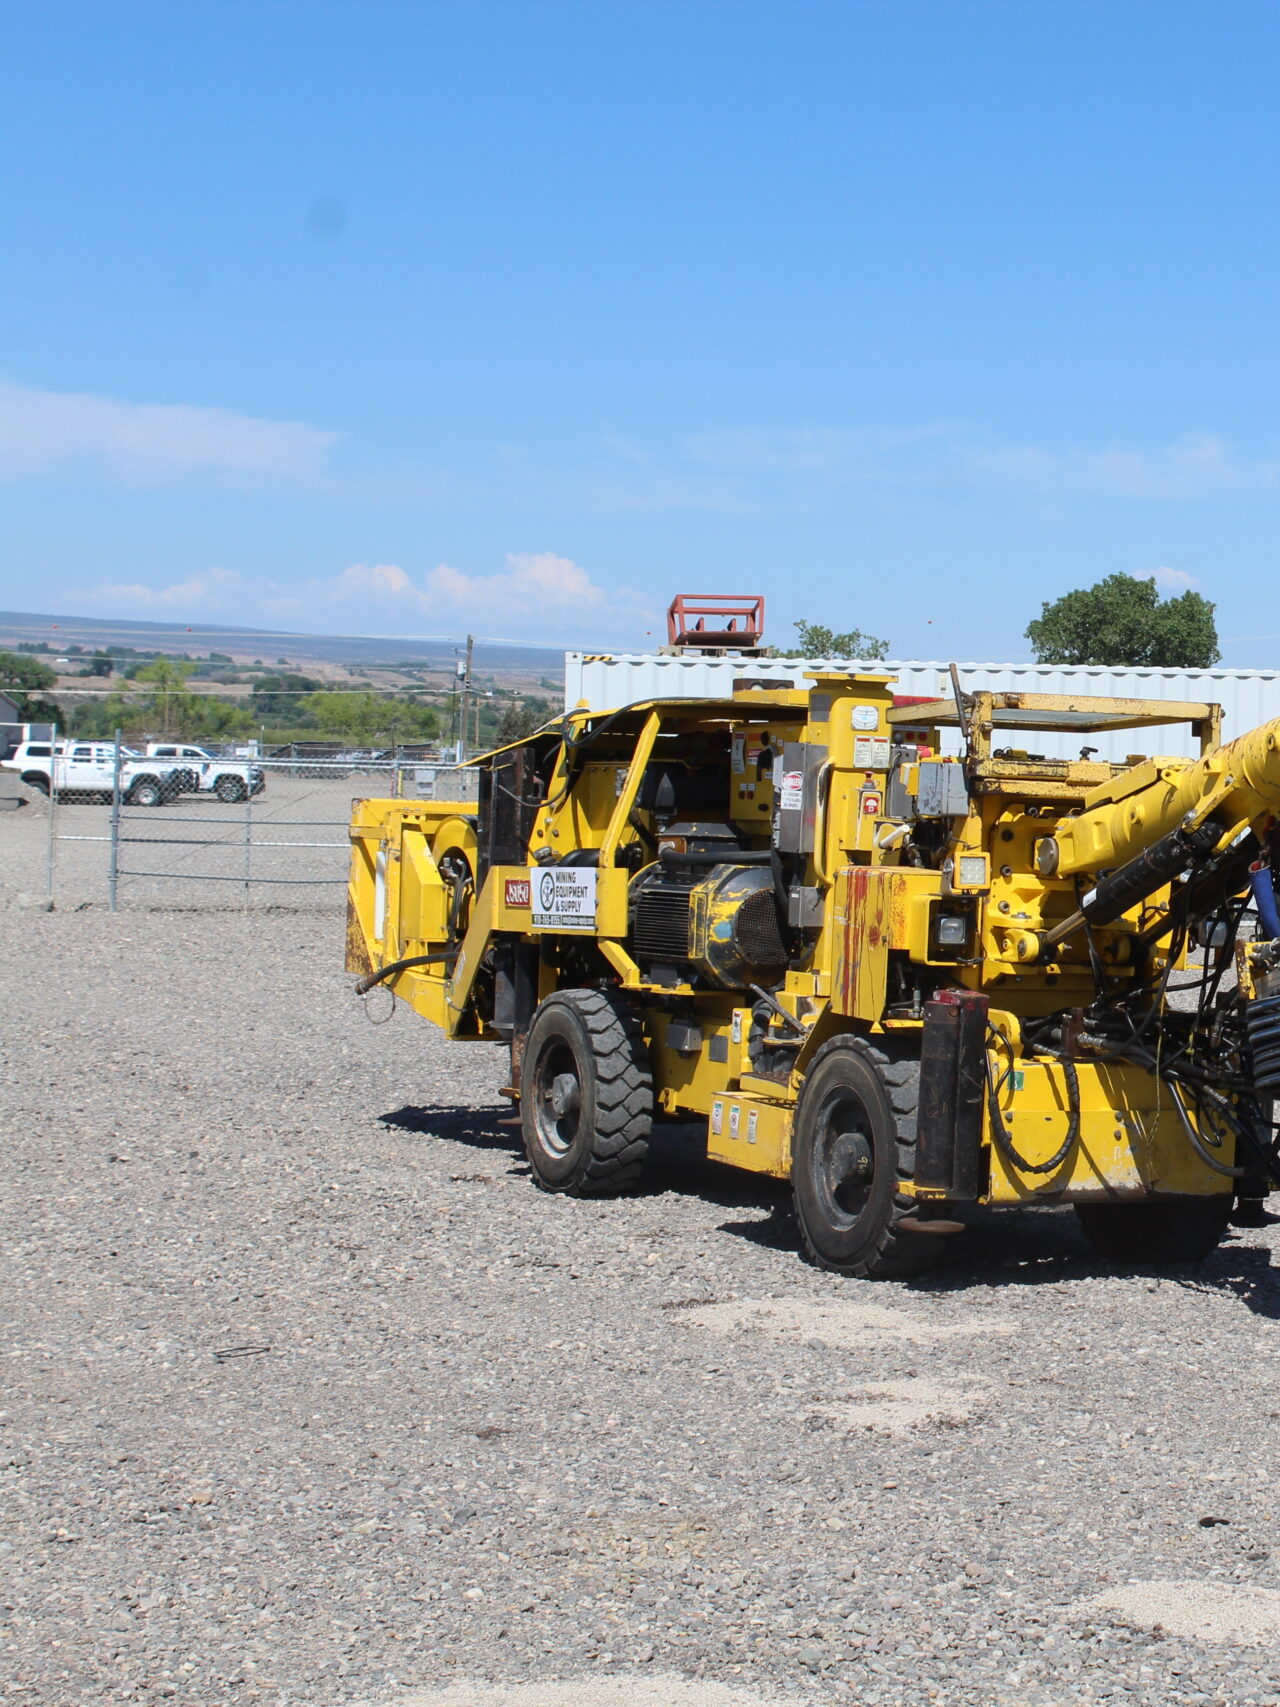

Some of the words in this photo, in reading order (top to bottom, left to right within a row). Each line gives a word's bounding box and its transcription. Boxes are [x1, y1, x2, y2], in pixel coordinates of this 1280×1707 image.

[555, 872, 576, 883] MINING
[555, 886, 588, 898] EQUIPMENT
[555, 901, 560, 912] &
[560, 901, 581, 912] SUPPLY
